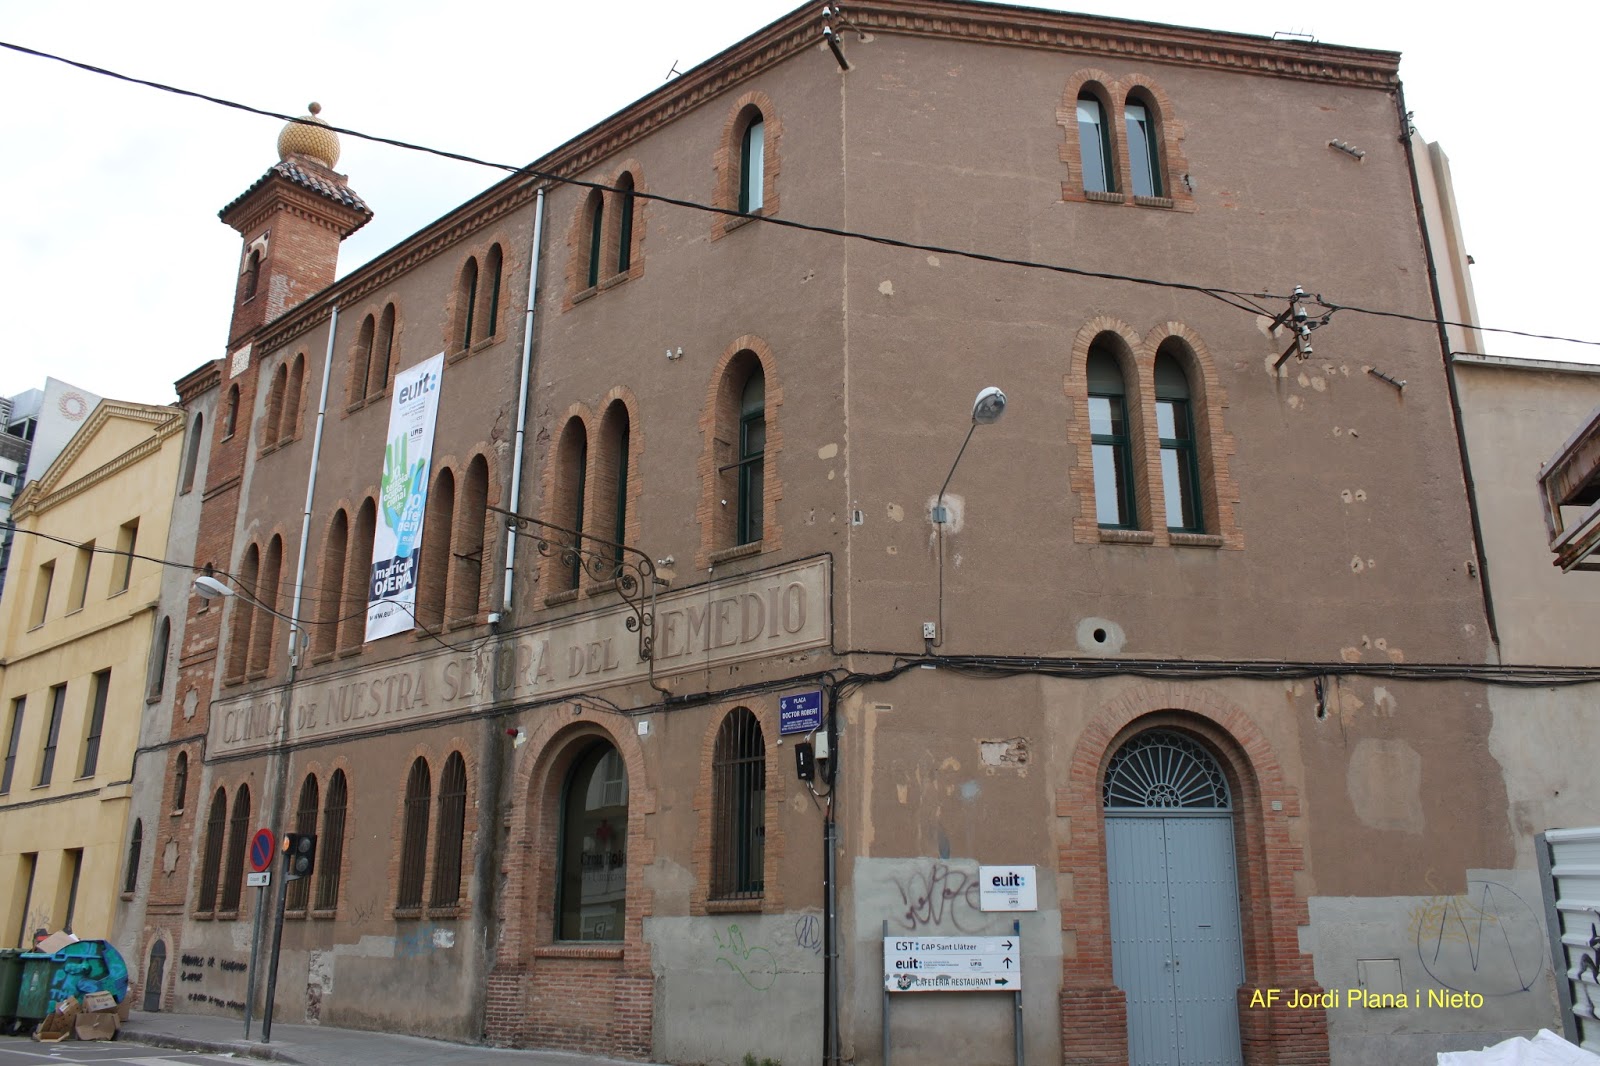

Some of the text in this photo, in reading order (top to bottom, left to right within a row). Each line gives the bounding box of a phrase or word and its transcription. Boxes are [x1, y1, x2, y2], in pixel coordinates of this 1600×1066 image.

[296, 703, 318, 732] DE
[325, 670, 430, 726] NUESTRA
[568, 637, 620, 680] DEL
[782, 708, 818, 719] DOCTOR ROBERT
[921, 943, 935, 951] CAP
[937, 943, 952, 951] Sant
[915, 977, 992, 987] CAFETERIA RESTAURANT
